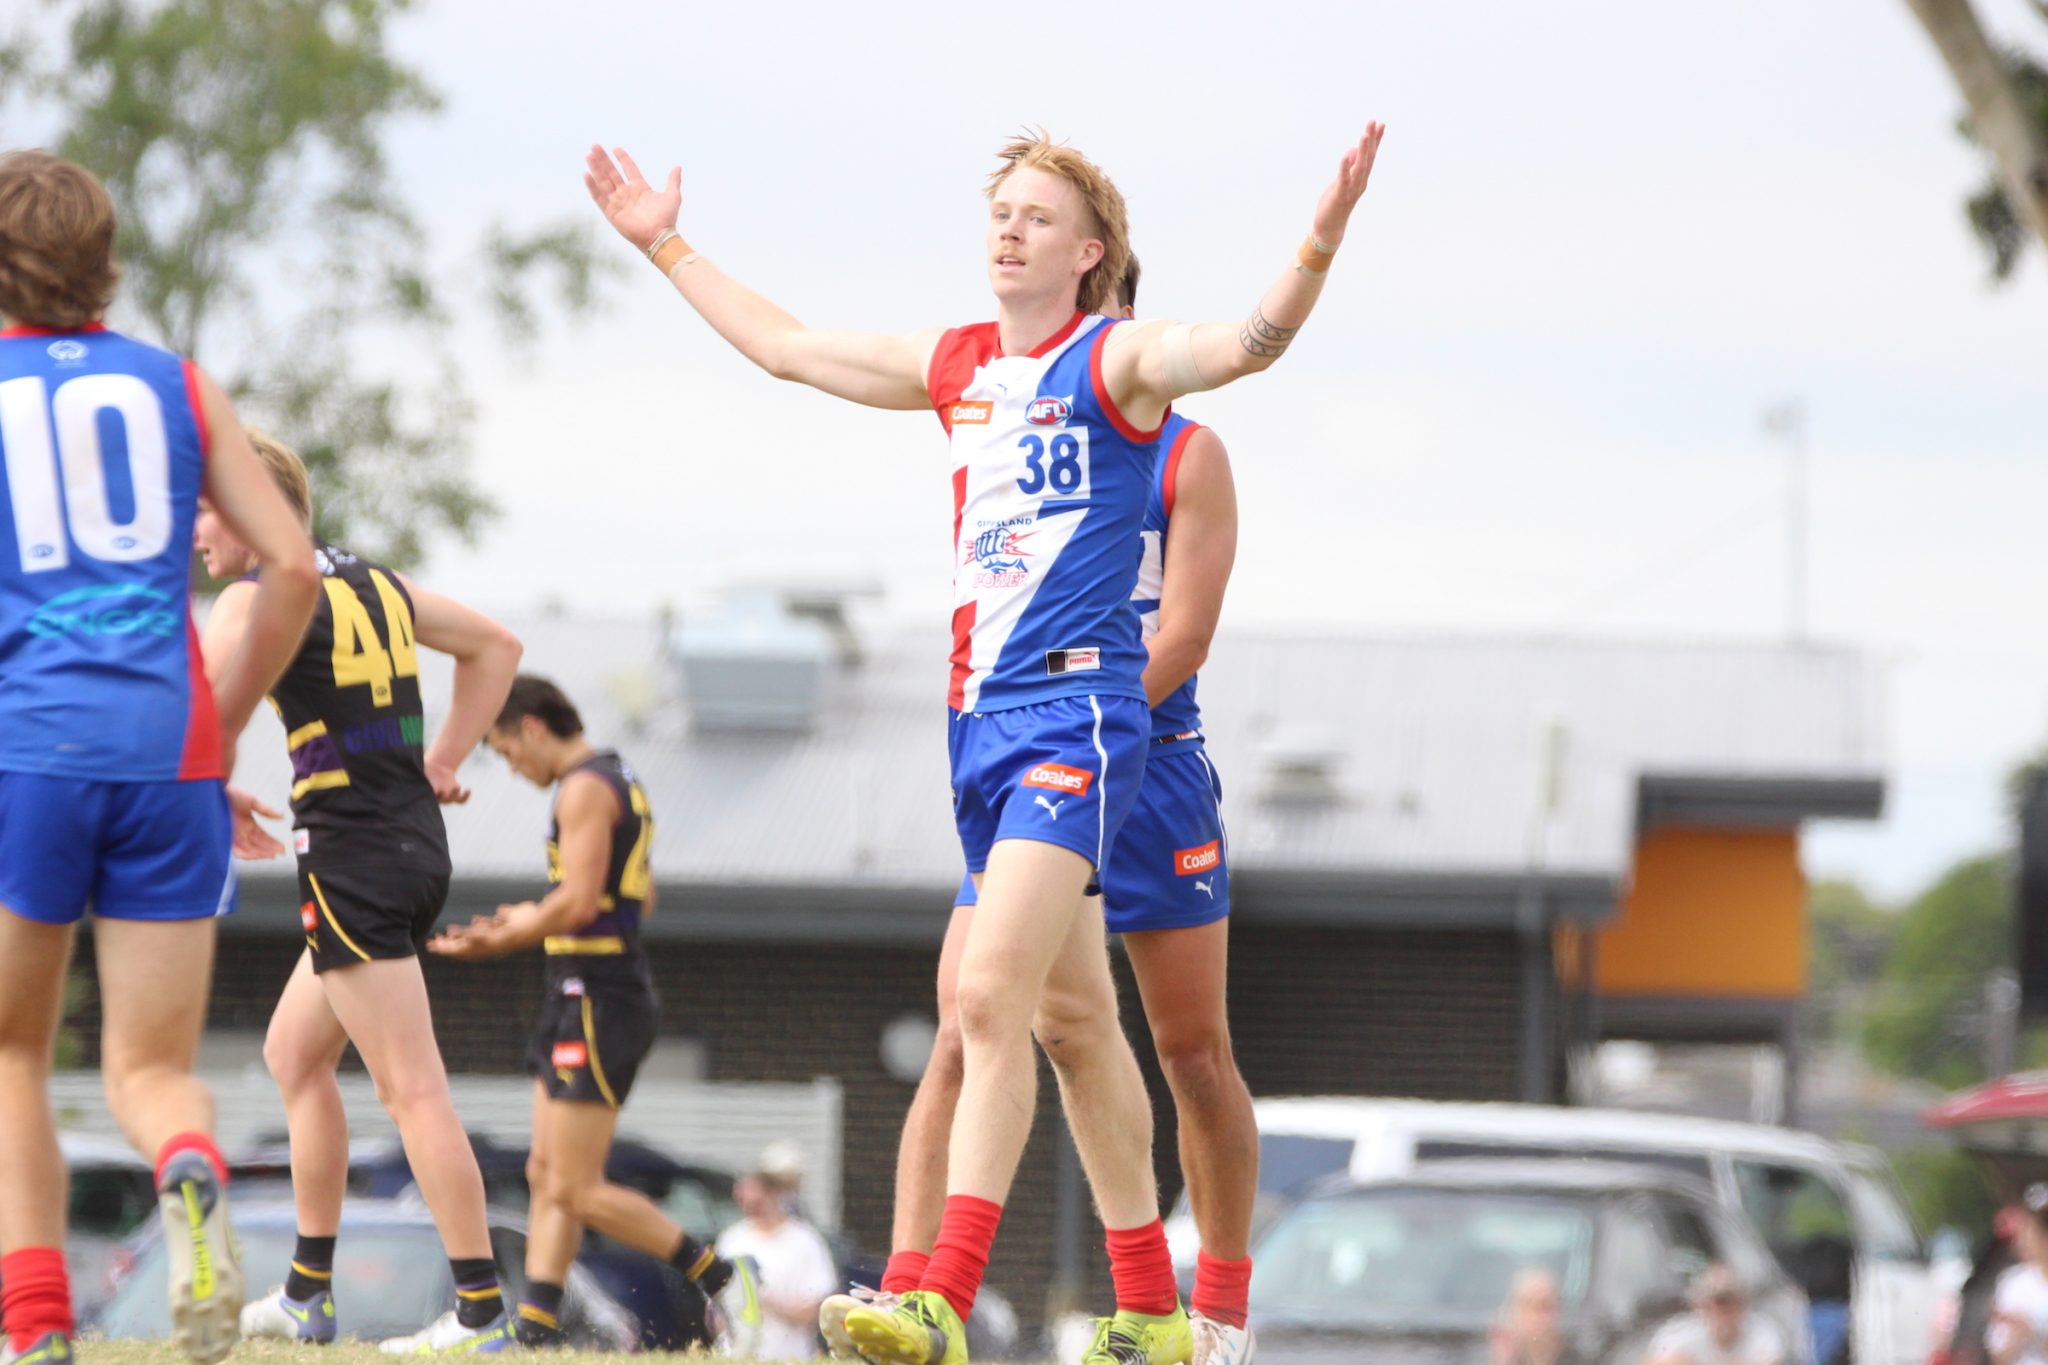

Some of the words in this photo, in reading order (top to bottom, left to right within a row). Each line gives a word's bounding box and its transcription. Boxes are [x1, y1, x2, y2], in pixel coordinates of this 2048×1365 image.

[952, 405, 988, 420] Coates
[1027, 403, 1068, 419] AFL
[0, 373, 173, 573] 10
[1016, 433, 1082, 495] 38
[973, 572, 1029, 588] POWER
[323, 568, 418, 708] 44
[1029, 767, 1084, 790] Coates
[1182, 848, 1217, 870] Coates
